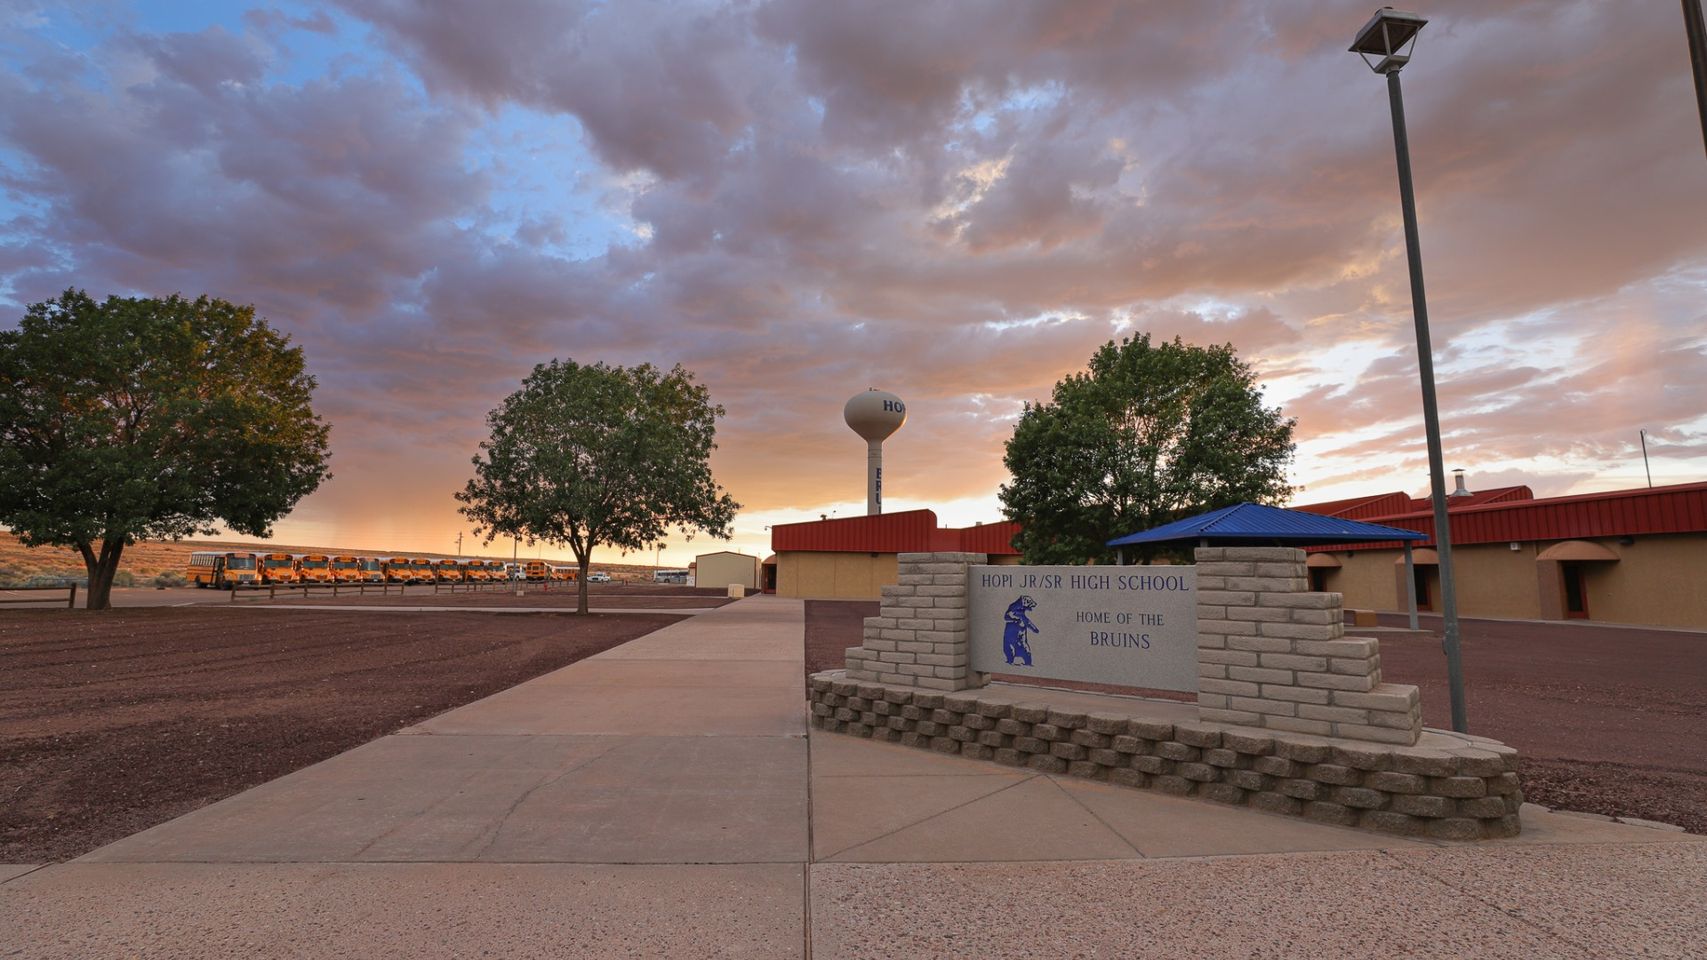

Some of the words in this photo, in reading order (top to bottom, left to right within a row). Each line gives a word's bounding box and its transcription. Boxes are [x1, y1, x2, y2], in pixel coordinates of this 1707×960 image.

[982, 574, 1013, 588] HOPI
[1019, 574, 1062, 589] JR/SR
[1070, 575, 1110, 590] HIGH
[1118, 575, 1189, 591] SCHOOL
[1076, 611, 1111, 624] HOME
[1116, 612, 1132, 625] OF
[1138, 613, 1165, 626] THE
[1090, 631, 1150, 649] BRUINS
